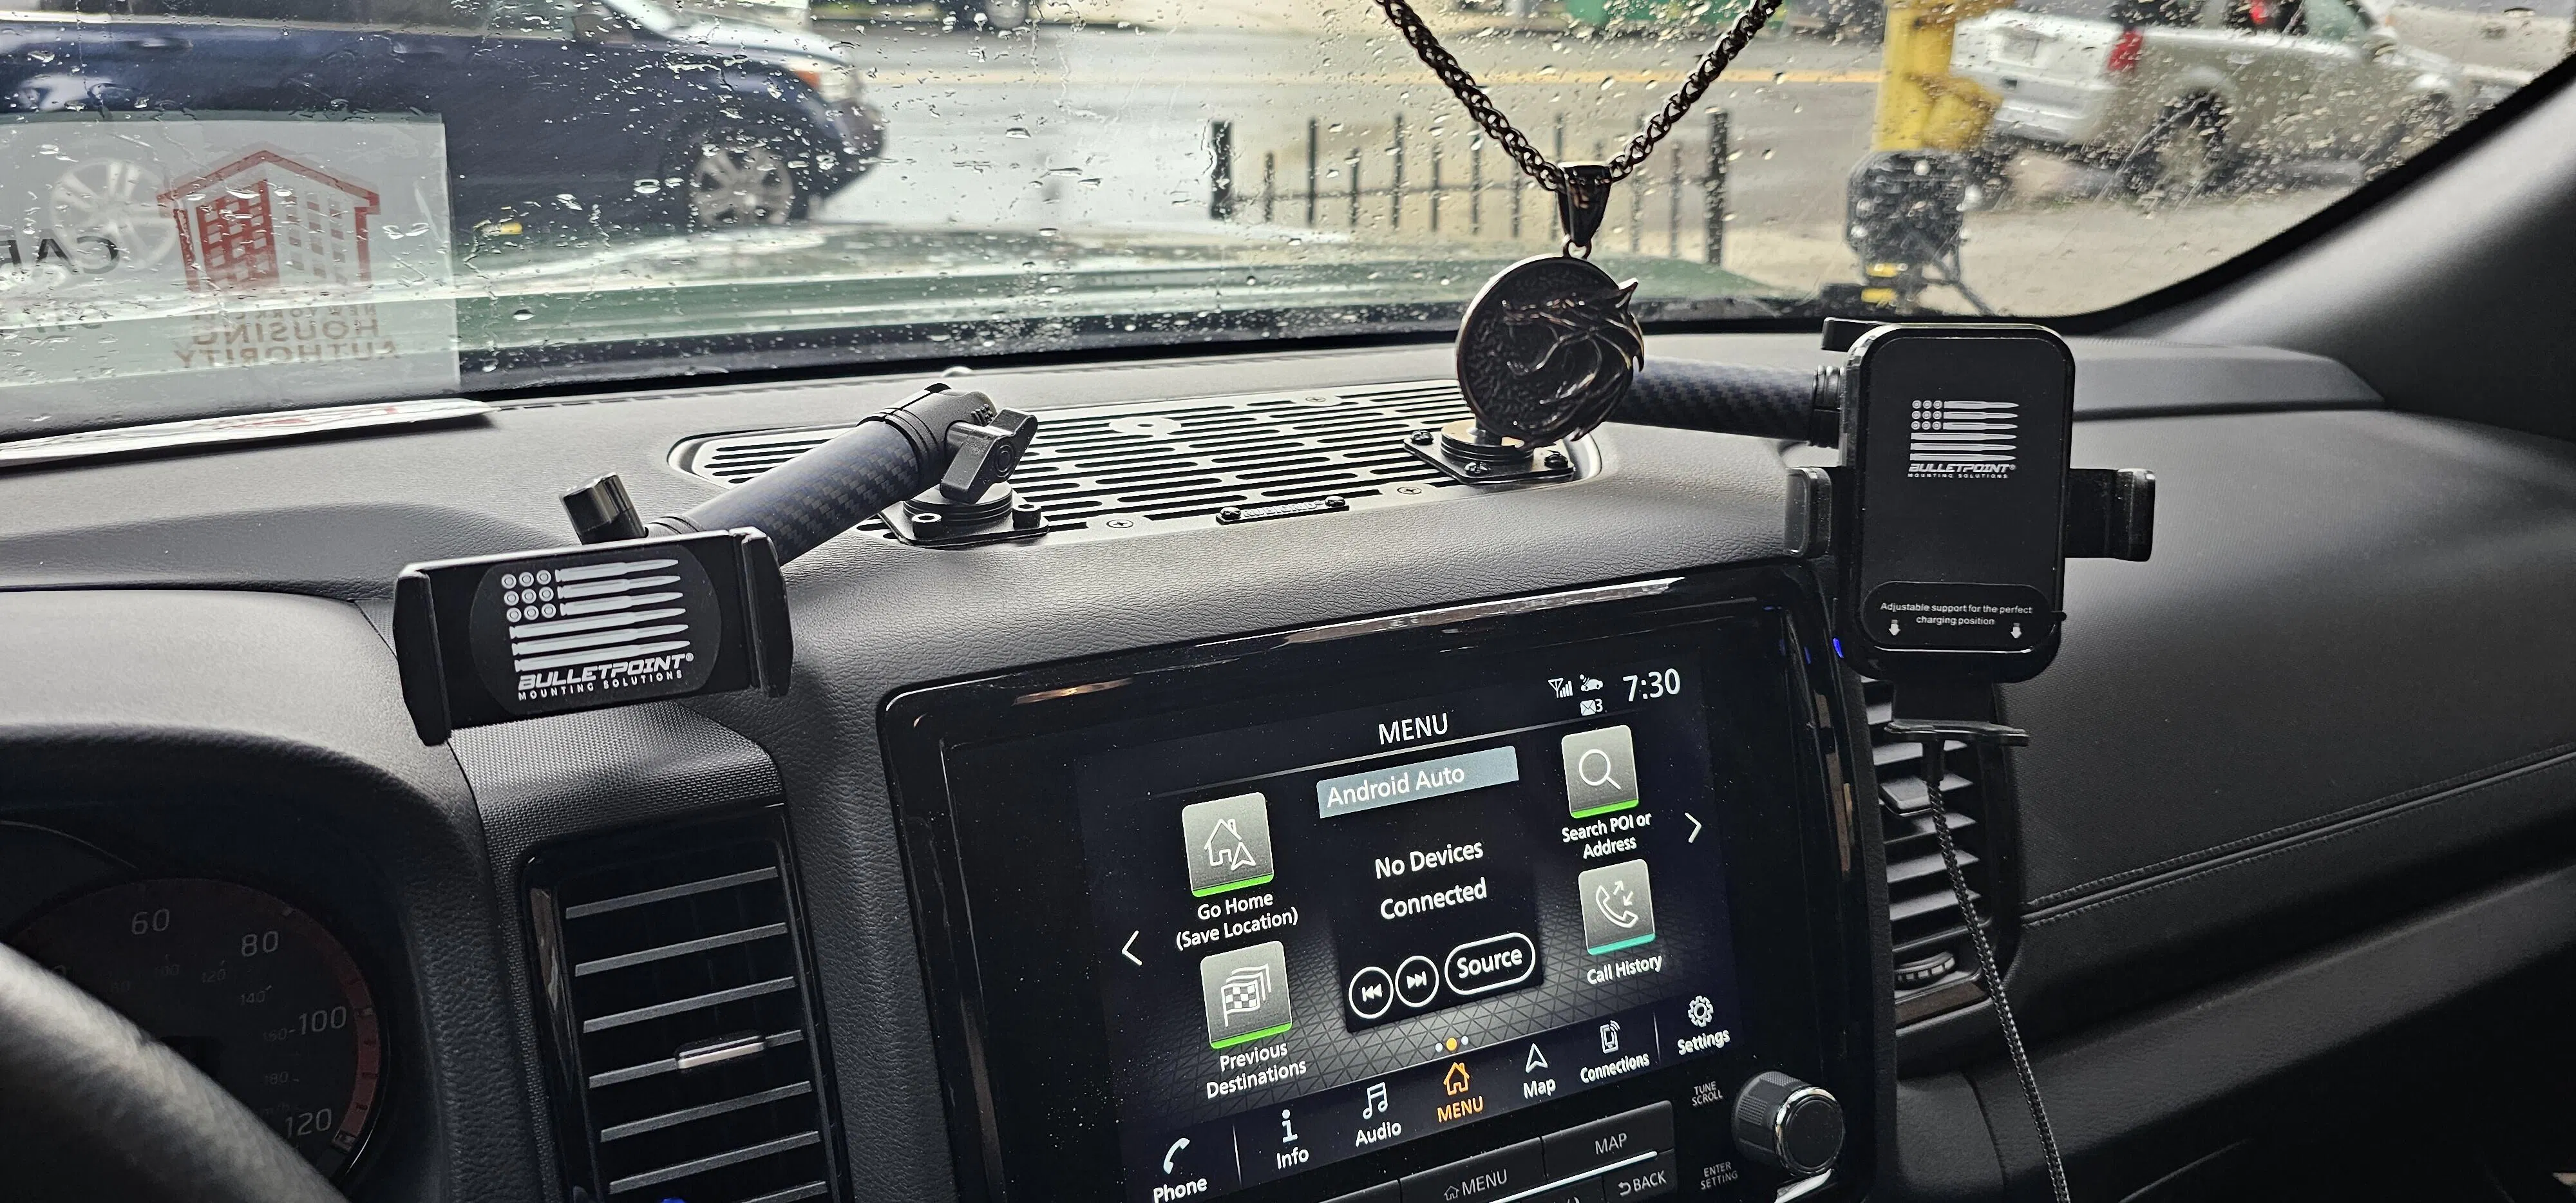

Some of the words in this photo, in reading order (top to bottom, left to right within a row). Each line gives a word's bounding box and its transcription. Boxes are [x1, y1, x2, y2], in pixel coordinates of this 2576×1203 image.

[1880, 602, 1930, 612] Adjustable
[1931, 604, 1967, 613] support
[1983, 604, 1998, 612] the
[1999, 605, 2033, 614] perfect
[1916, 615, 1957, 626] charging
[1958, 616, 1995, 625] position
[518, 683, 594, 701] MOUNTING
[603, 670, 683, 689] SOLUTIONS
[1623, 668, 1681, 702] 7:30
[1595, 699, 1604, 712] 3
[1378, 713, 1449, 744] MENU
[1327, 777, 1410, 808] Android
[1416, 766, 1464, 791] Auto
[1562, 819, 1607, 843] Search
[1610, 815, 1634, 833] POI
[1636, 813, 1652, 828] or
[1375, 857, 1406, 879] No
[1410, 841, 1483, 871] Devices
[1583, 837, 1636, 859] Address
[1197, 904, 1222, 920] Go
[1226, 892, 1274, 916] Home
[1380, 876, 1487, 920] Connected
[130, 907, 171, 936] 60
[1176, 929, 1219, 951] (Save
[1224, 907, 1299, 939] Location)
[241, 930, 279, 957] 80
[201, 968, 227, 984] 120
[1457, 947, 1522, 980] Source
[1587, 964, 1613, 985] Call
[1615, 955, 1663, 979] History
[299, 1005, 347, 1035] 100
[1677, 1028, 1730, 1056] Settings
[1219, 1043, 1288, 1072] Previous
[1580, 1051, 1649, 1085] Connections
[1206, 1061, 1307, 1099] Destinations
[1524, 1076, 1557, 1099] Map
[1694, 1081, 1716, 1095] TUNE
[1437, 1096, 1484, 1123] MENU
[1692, 1090, 1723, 1107] SCROLL
[284, 1108, 332, 1139] 120
[1355, 1121, 1402, 1147] Audio
[1595, 1132, 1628, 1154] MAP
[1276, 1148, 1309, 1170] Info
[1703, 1161, 1732, 1178] ENTER
[1153, 1178, 1208, 1203] Phone
[1462, 1168, 1508, 1196] MENU
[1633, 1170, 1667, 1192] BACK
[1700, 1170, 1739, 1190] SETTING
